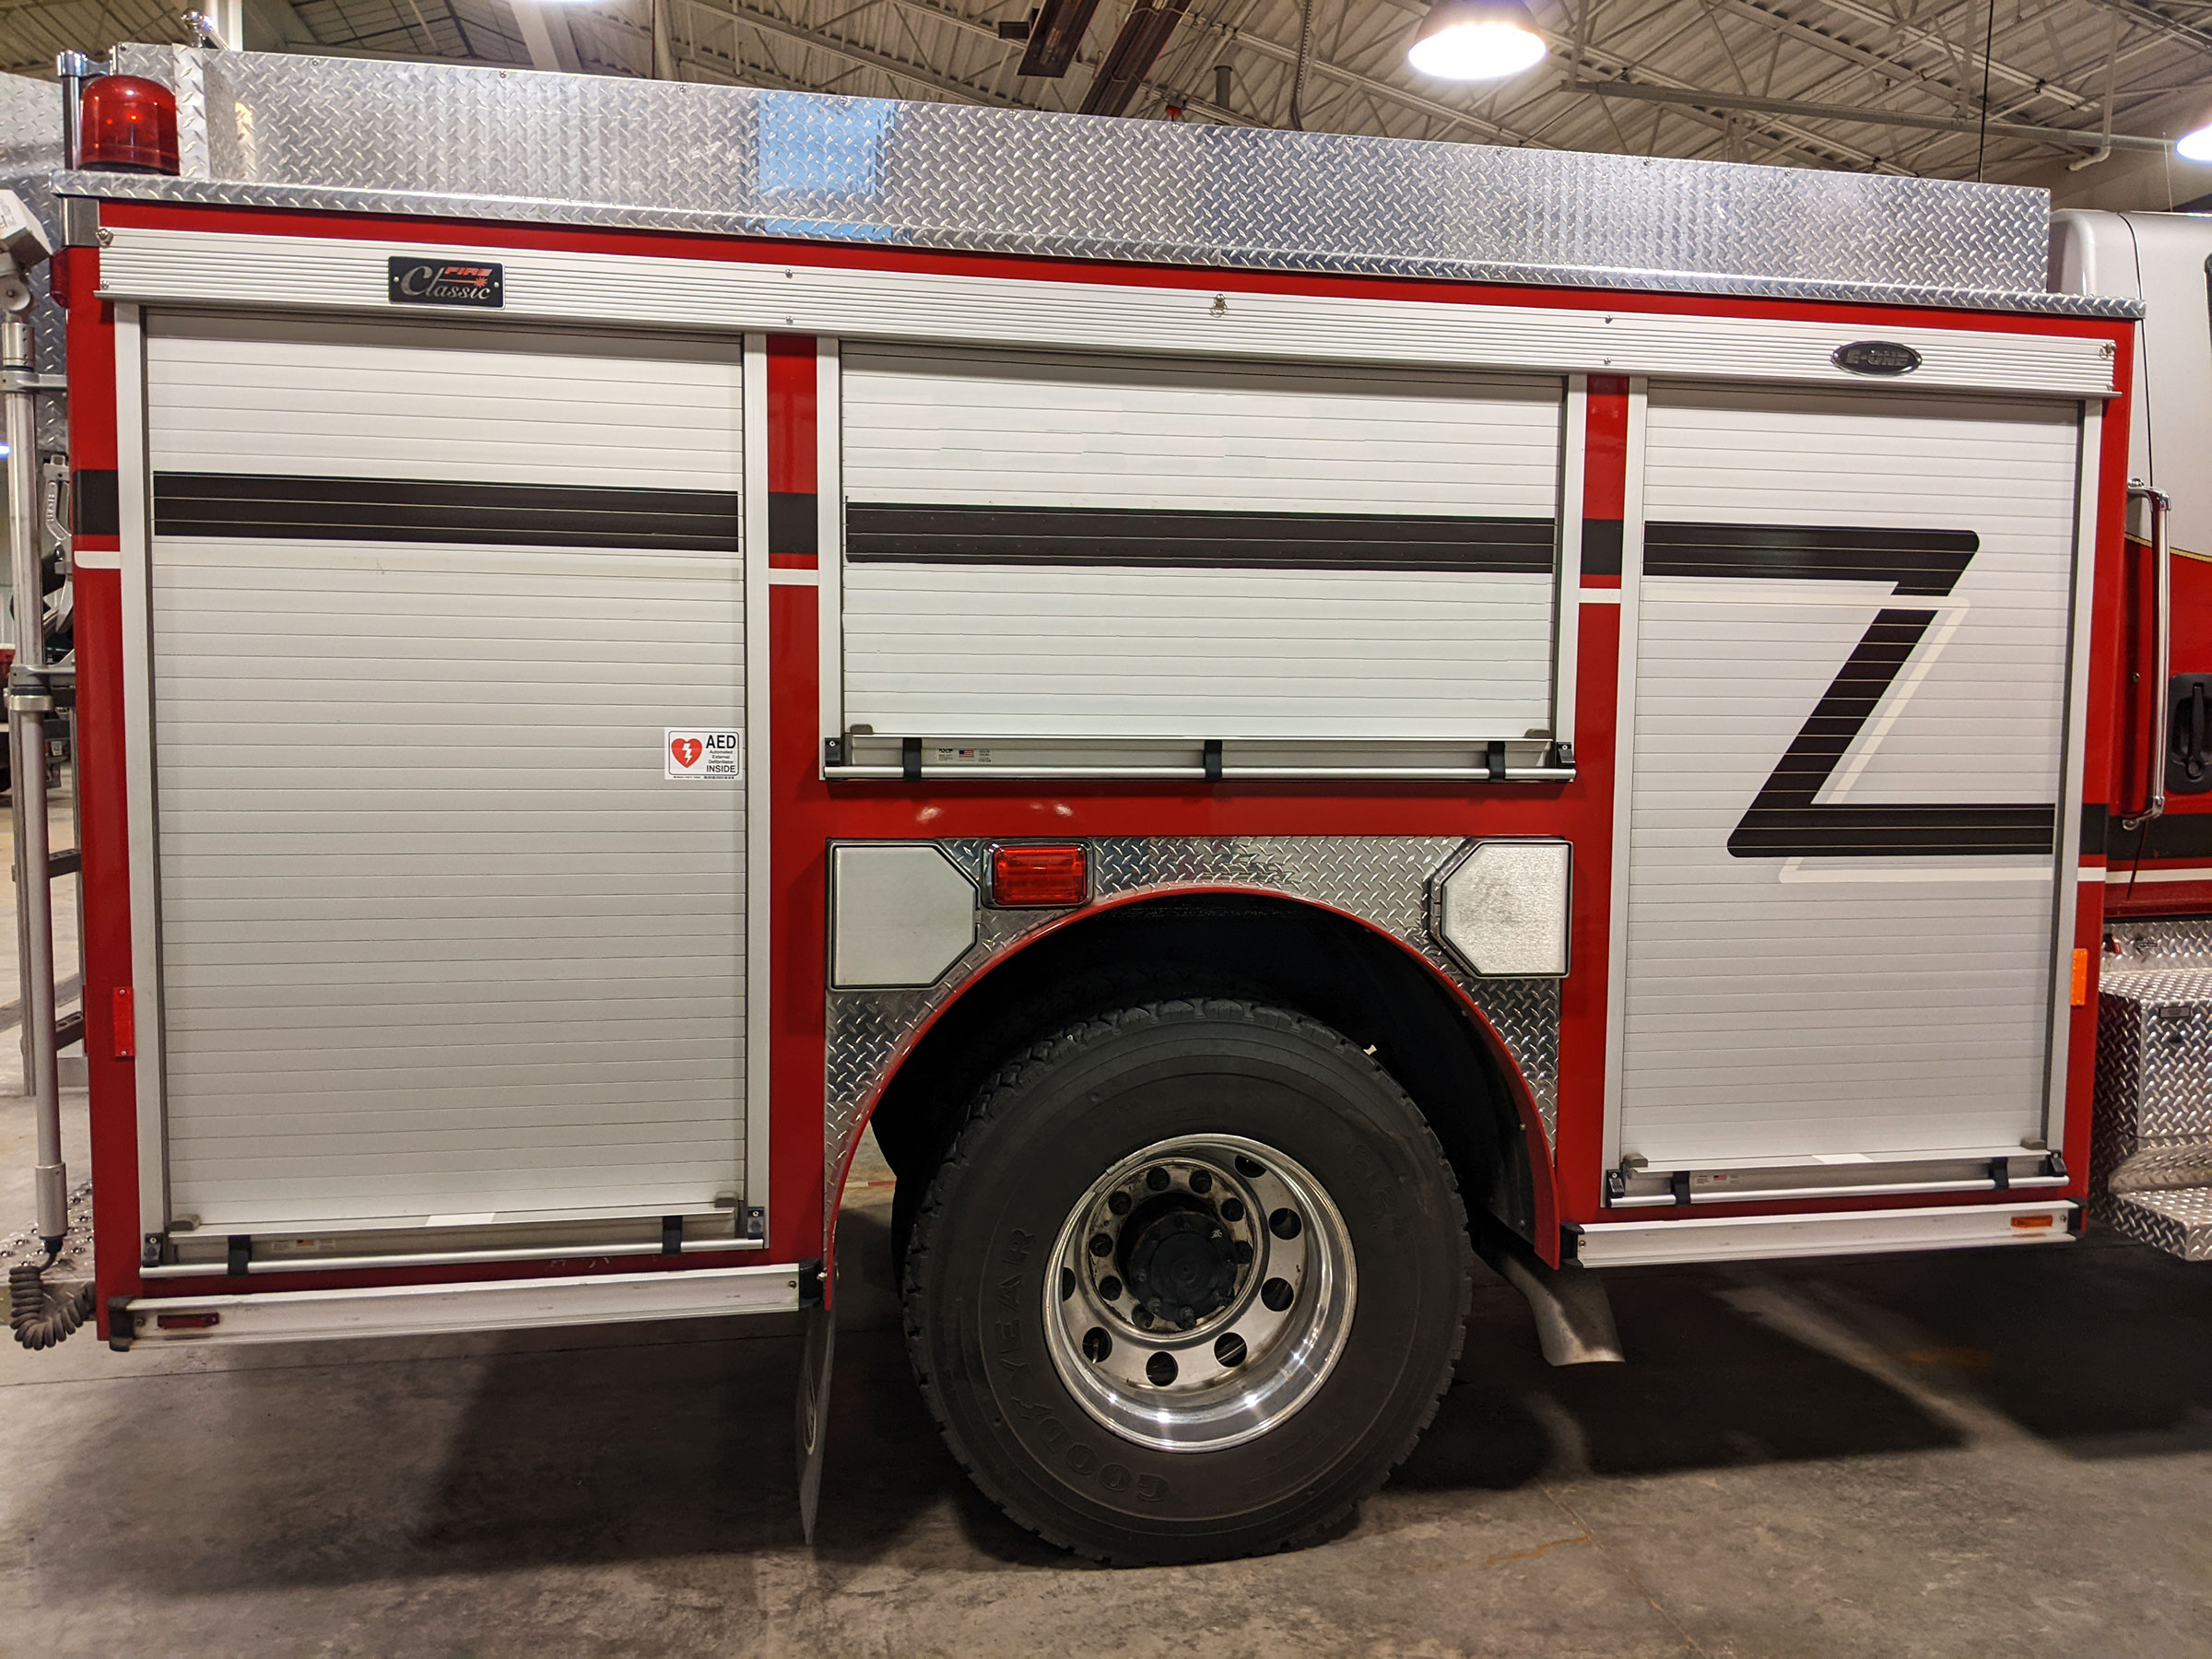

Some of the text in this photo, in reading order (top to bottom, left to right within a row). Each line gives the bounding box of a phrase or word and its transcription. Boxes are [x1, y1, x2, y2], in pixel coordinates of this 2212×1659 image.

[444, 266, 493, 276] FIRE
[401, 265, 490, 300] Classic
[706, 735, 736, 748] AED
